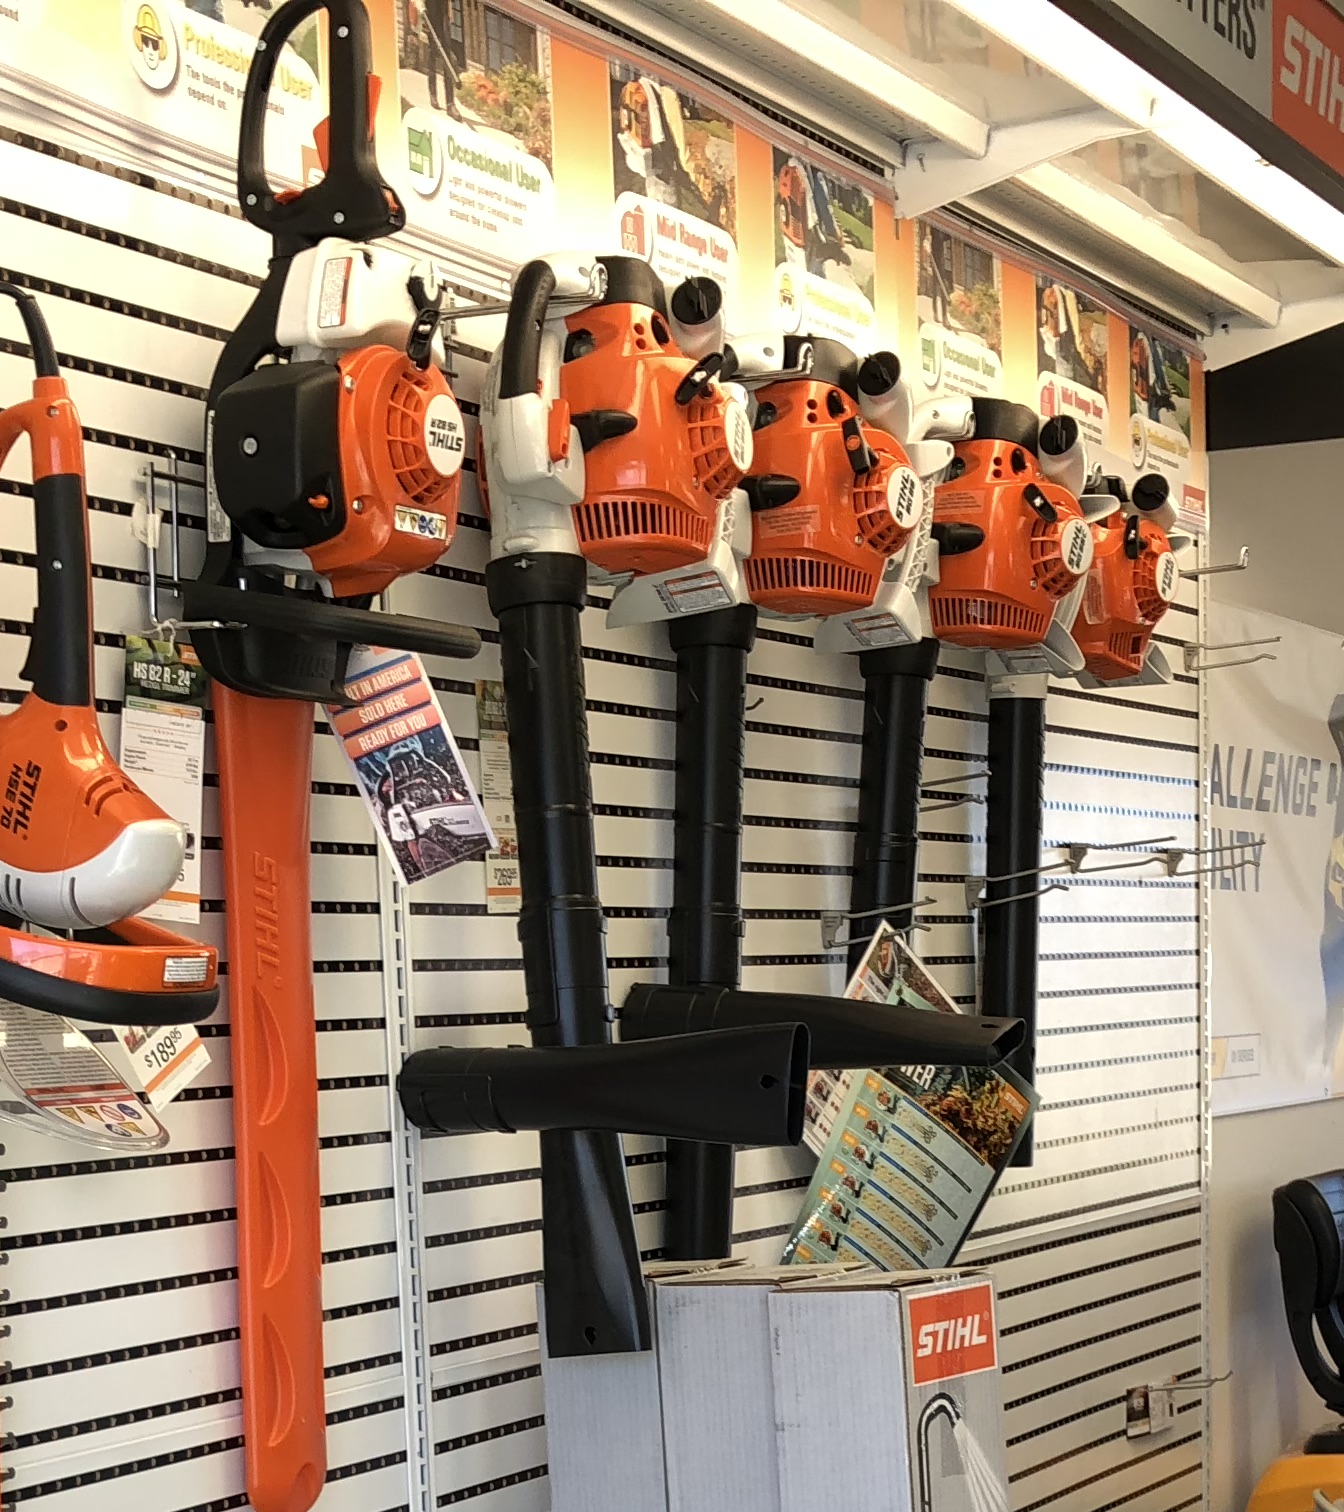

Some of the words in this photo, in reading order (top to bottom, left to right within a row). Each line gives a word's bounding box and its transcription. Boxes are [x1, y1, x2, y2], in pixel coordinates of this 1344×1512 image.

[447, 134, 513, 183] Occasional
[515, 162, 541, 193] User
[656, 213, 676, 241] Mid
[680, 222, 707, 257] Range
[429, 430, 464, 452] STIHL
[895, 474, 910, 523] STIHL
[133, 660, 147, 680] HS
[149, 663, 162, 683] 82
[163, 666, 172, 684] R
[360, 681, 373, 696] IN
[372, 665, 413, 691] AMERICA
[358, 702, 385, 724] SOLD
[383, 693, 409, 714] HERE
[358, 727, 390, 752] READY
[388, 720, 409, 738] FOR
[406, 713, 427, 732] YOU
[5, 763, 23, 804] HSE
[13, 760, 42, 835] STIHL
[0, 805, 14, 830] 70
[254, 851, 280, 979] STIHL
[915, 1312, 988, 1359] STIHL
